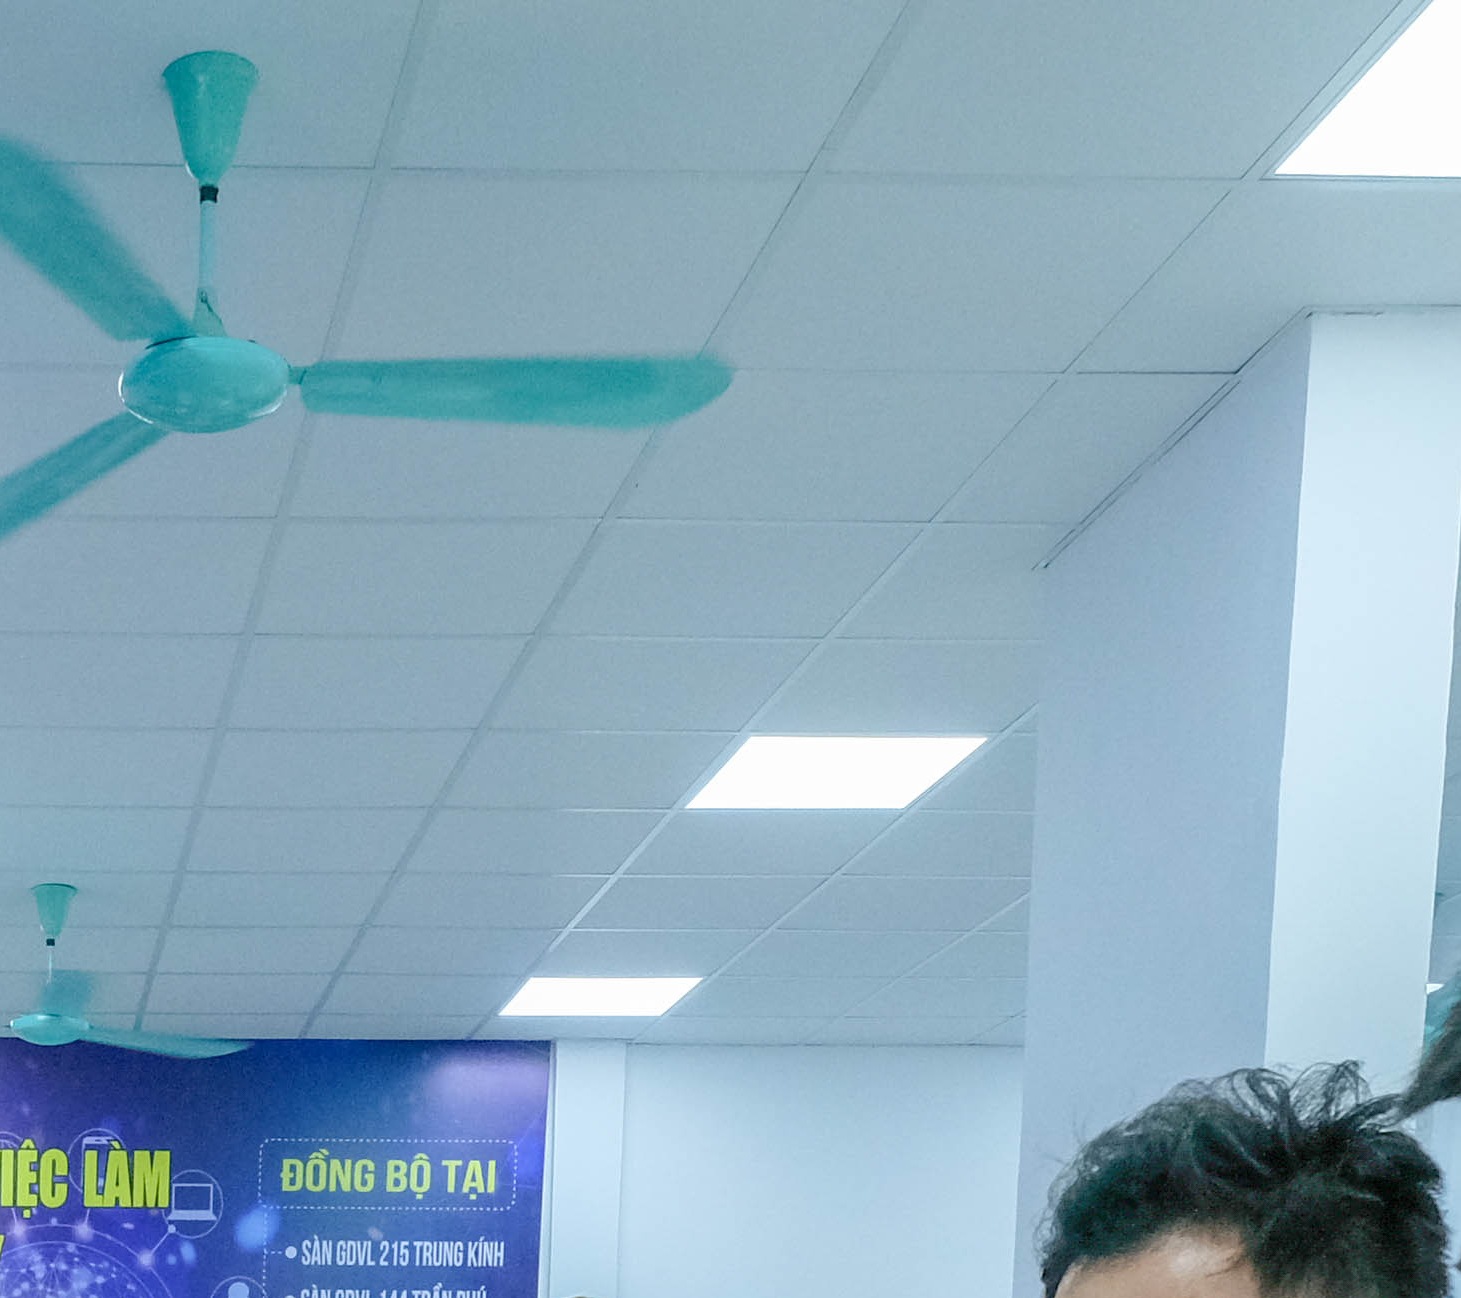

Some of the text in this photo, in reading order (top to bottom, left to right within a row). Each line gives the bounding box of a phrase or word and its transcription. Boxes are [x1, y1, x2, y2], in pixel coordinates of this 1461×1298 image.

[82, 1140, 172, 1208] LÀM
[280, 1148, 497, 1200] ĐỒNG BỘ TẠI
[301, 1234, 505, 1268] SÀN GDVL 215 TRUNG KÍNH
